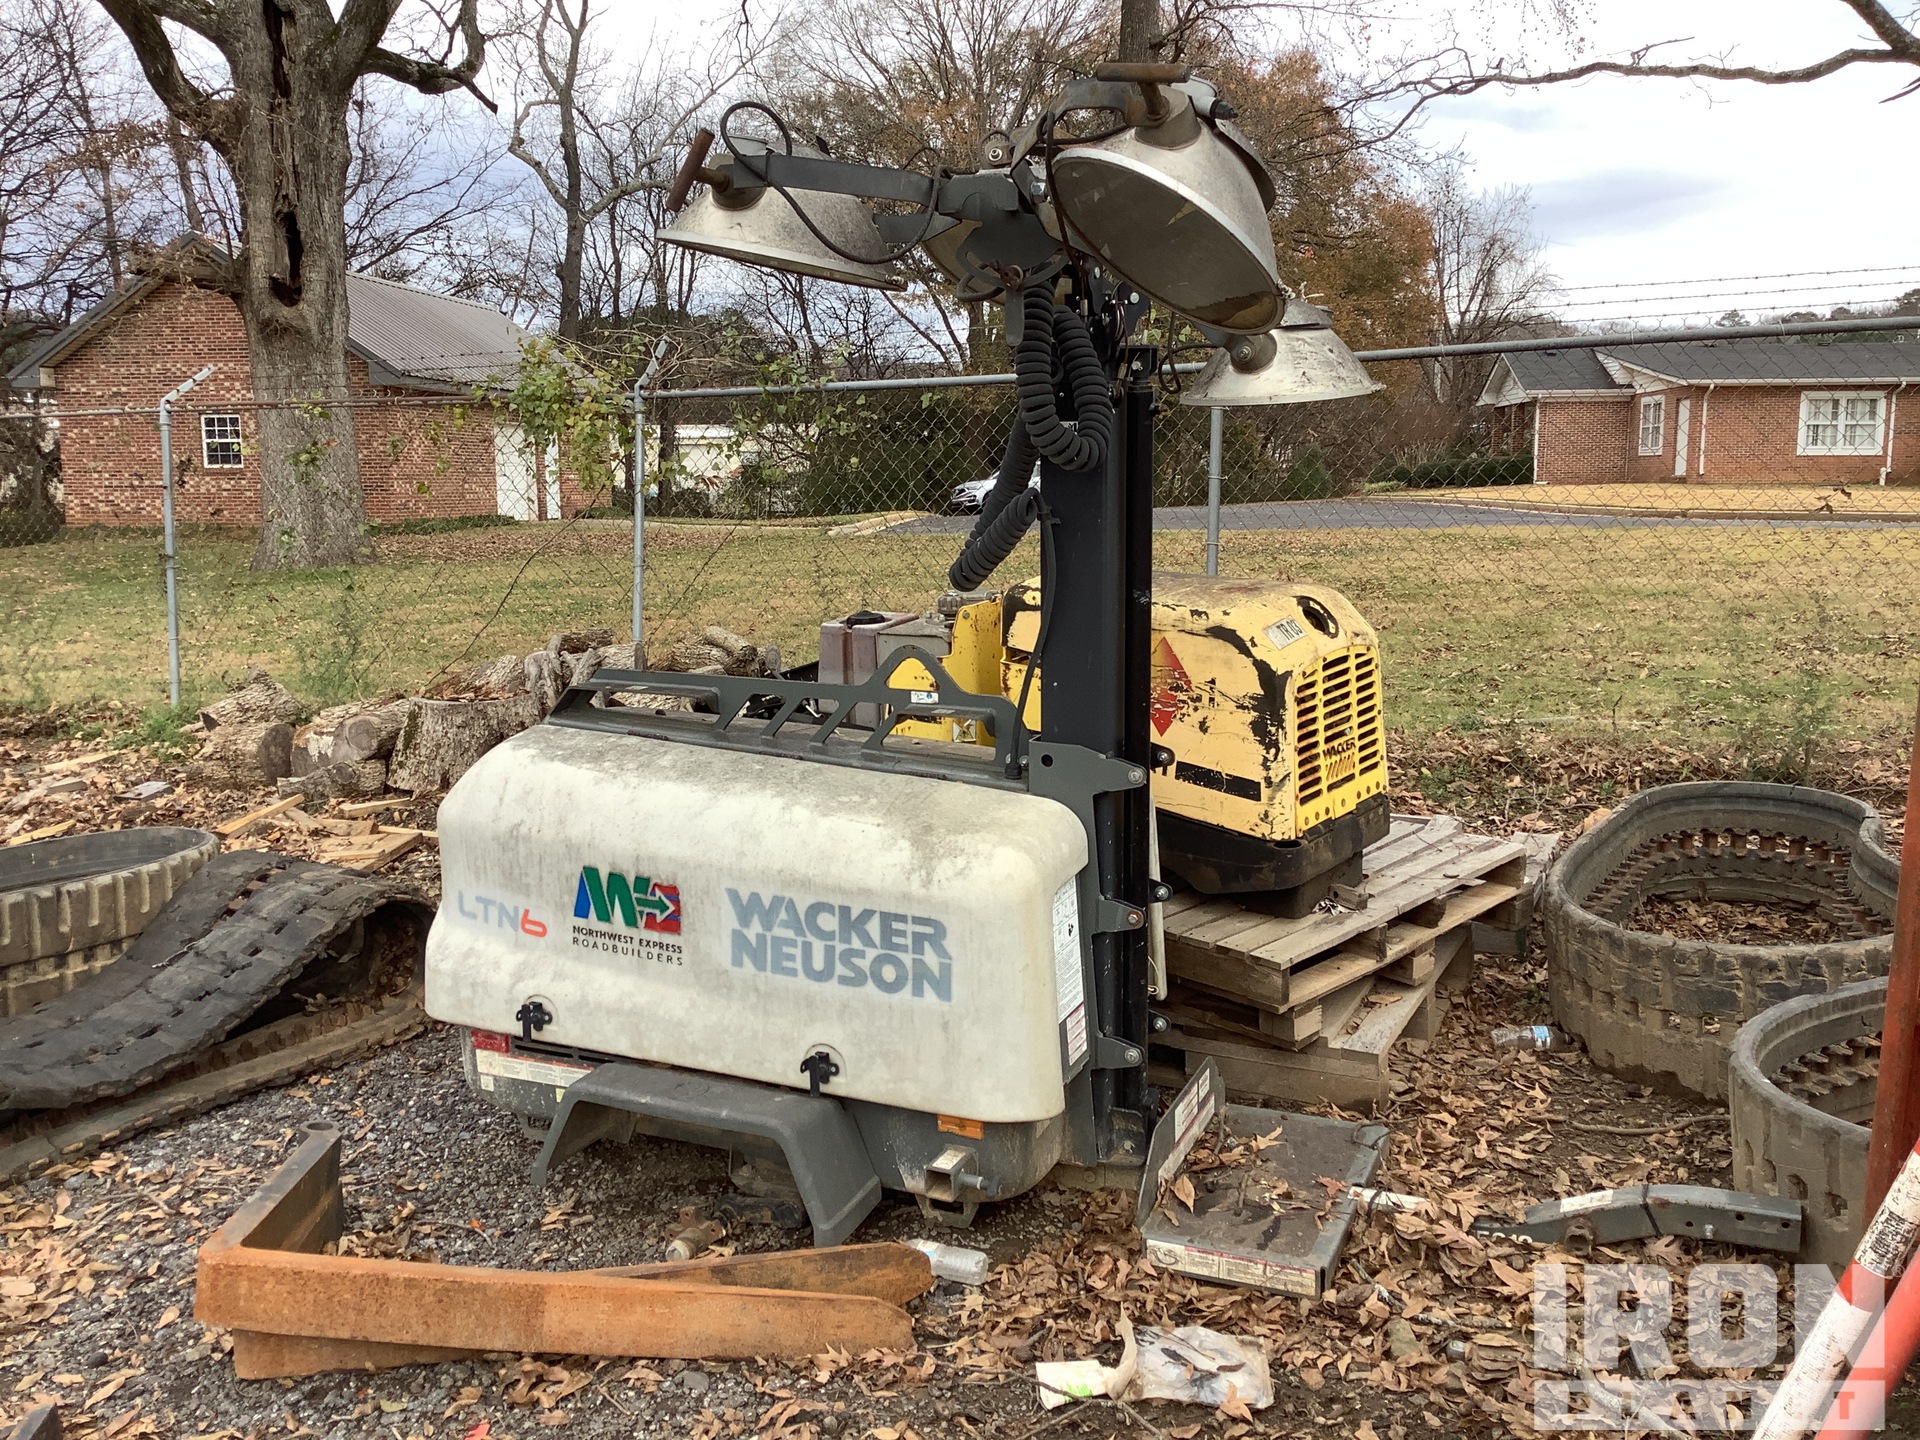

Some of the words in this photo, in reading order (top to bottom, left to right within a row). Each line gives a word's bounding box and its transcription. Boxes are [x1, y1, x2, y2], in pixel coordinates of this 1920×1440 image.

[1322, 737, 1356, 761] WACKER
[458, 890, 548, 938] LTN6
[725, 887, 953, 961] WACKER
[572, 925, 635, 945] NORTHWEST
[638, 938, 683, 954] EXPRESS
[572, 936, 683, 966] ROADBUILDERS
[731, 928, 953, 1003] NEUSON
